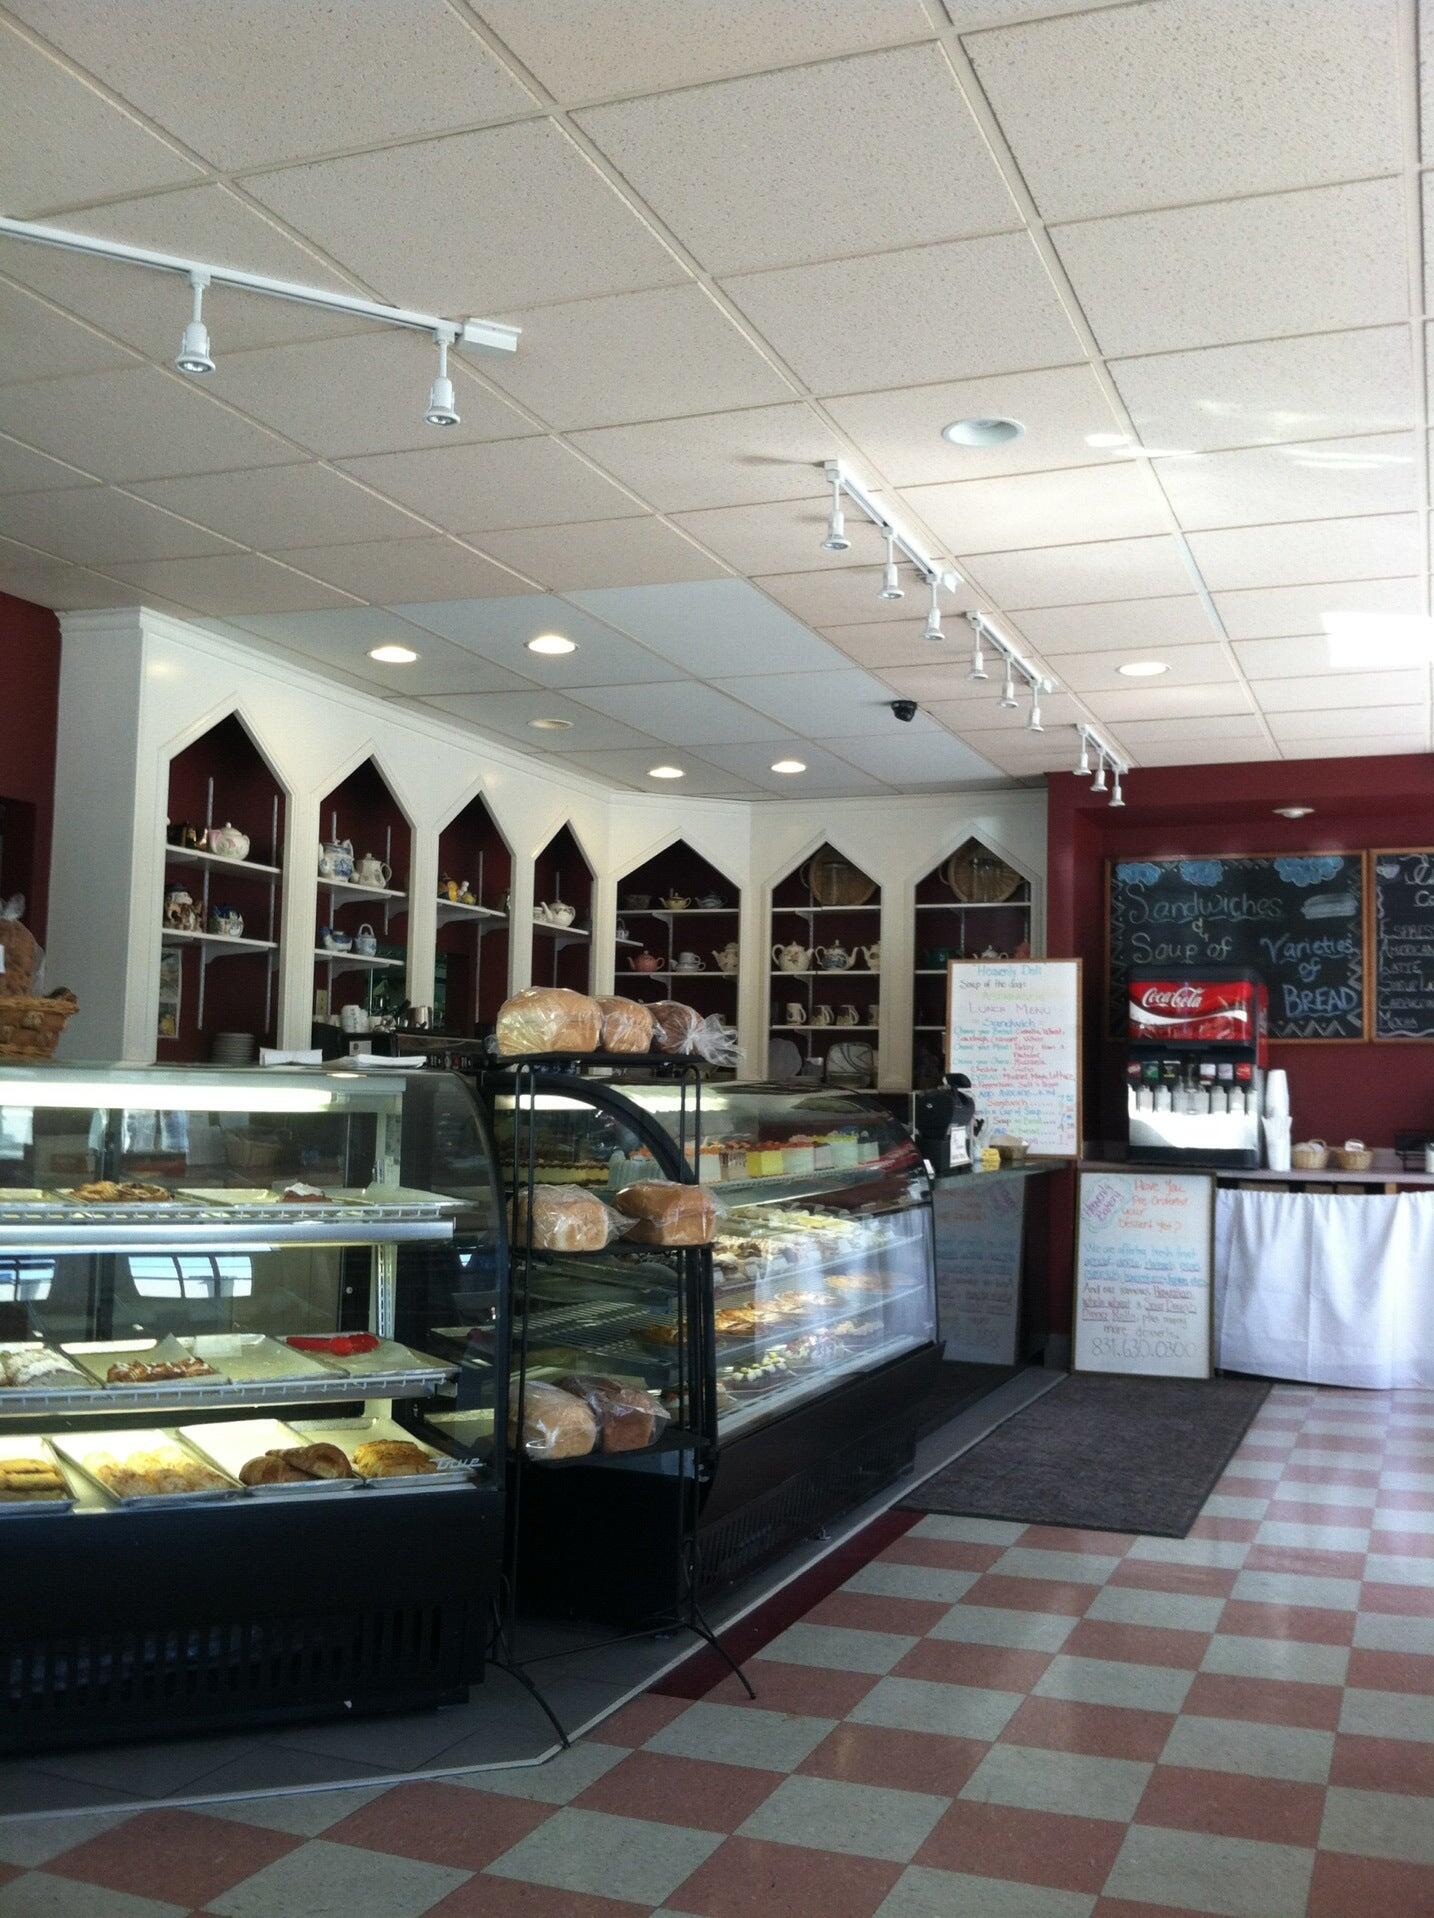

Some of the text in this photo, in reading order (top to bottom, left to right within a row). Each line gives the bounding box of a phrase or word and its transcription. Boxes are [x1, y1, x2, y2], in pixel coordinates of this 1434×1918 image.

[1126, 879, 1284, 924] Sandwiches
[1131, 931, 1233, 964] Soup of
[1260, 933, 1354, 965] Varieties
[1298, 957, 1321, 982] of
[994, 980, 1006, 988] the
[1142, 986, 1205, 1009] Coca-Cola
[1016, 1002, 1051, 1015] Menu
[1282, 984, 1359, 1018] BREAD
